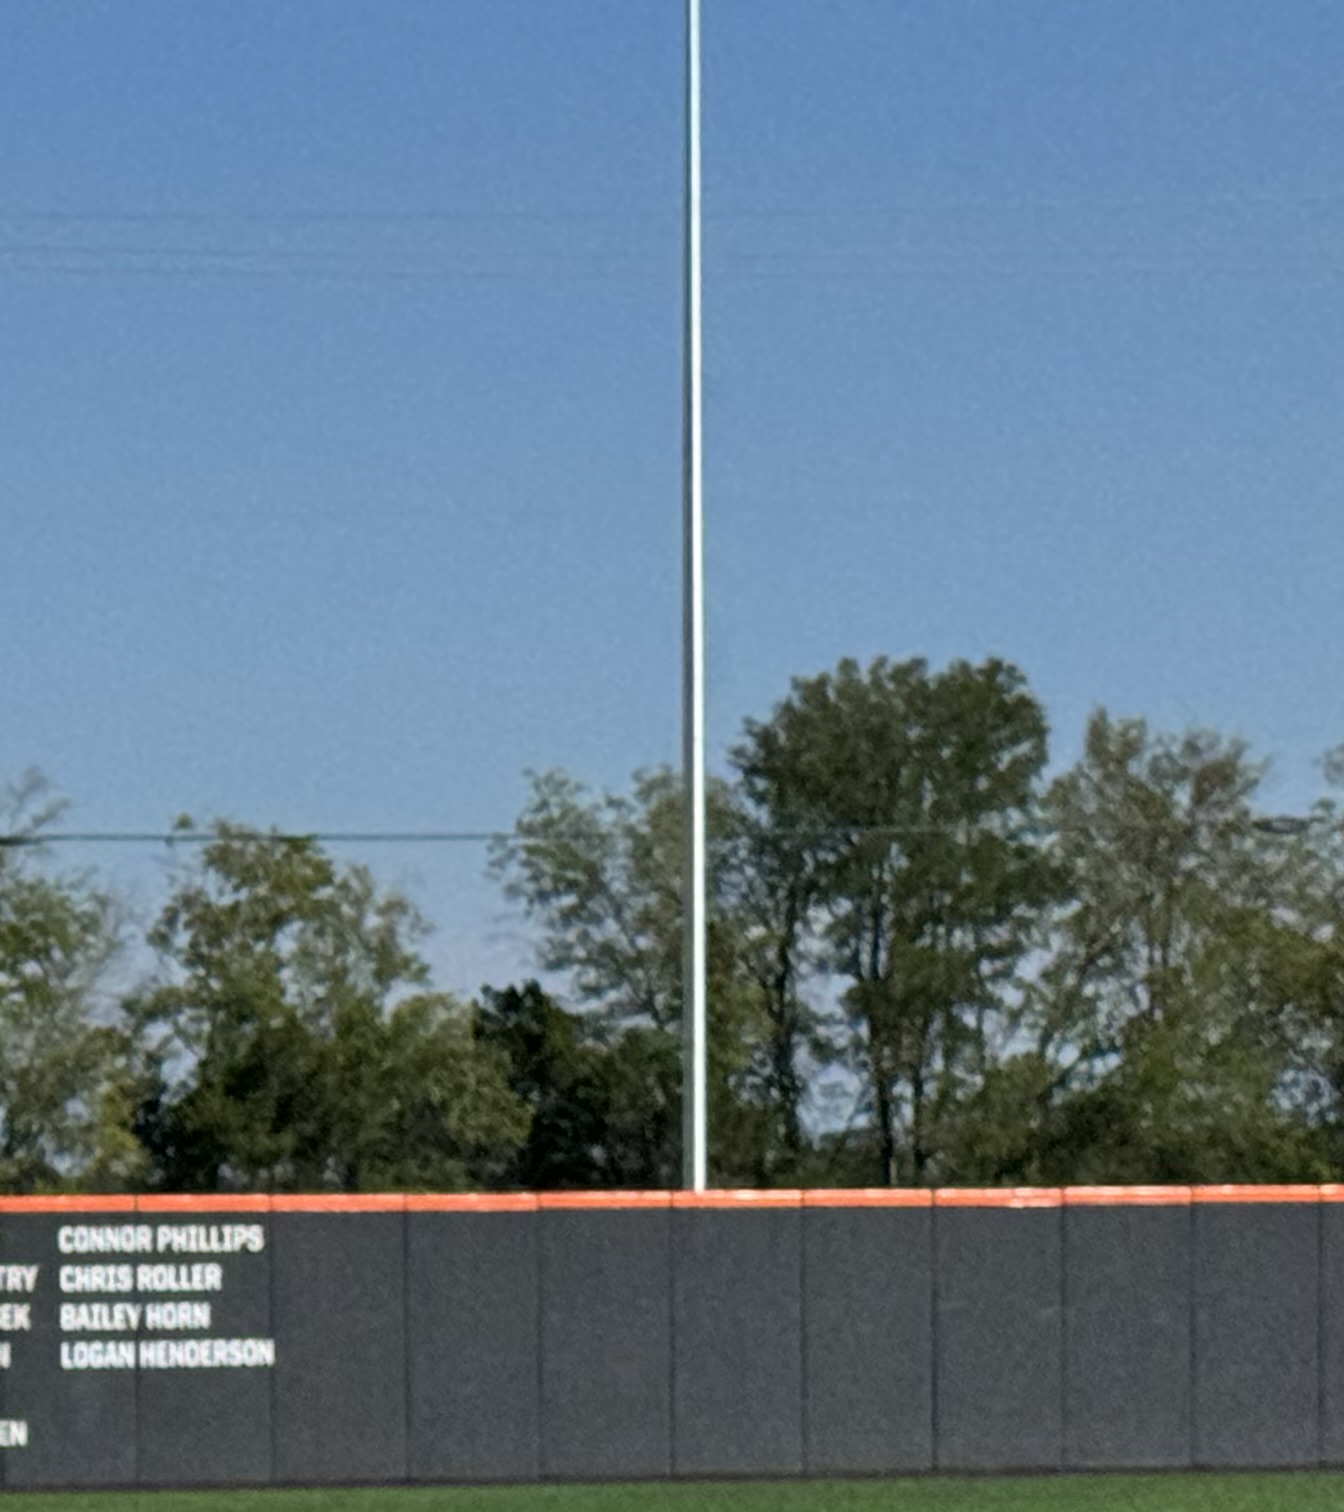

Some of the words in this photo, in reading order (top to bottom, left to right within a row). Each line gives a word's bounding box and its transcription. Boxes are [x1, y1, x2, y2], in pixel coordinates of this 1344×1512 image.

[57, 1224, 154, 1253] CONNOR
[156, 1223, 265, 1252] PHILLIPS
[59, 1263, 134, 1292] CHRIS
[136, 1262, 223, 1291] ROLLER
[59, 1302, 143, 1331] BAILEY
[144, 1300, 212, 1330] HORN
[60, 1340, 136, 1369] LOGAN
[138, 1337, 276, 1368] HENDERSON
